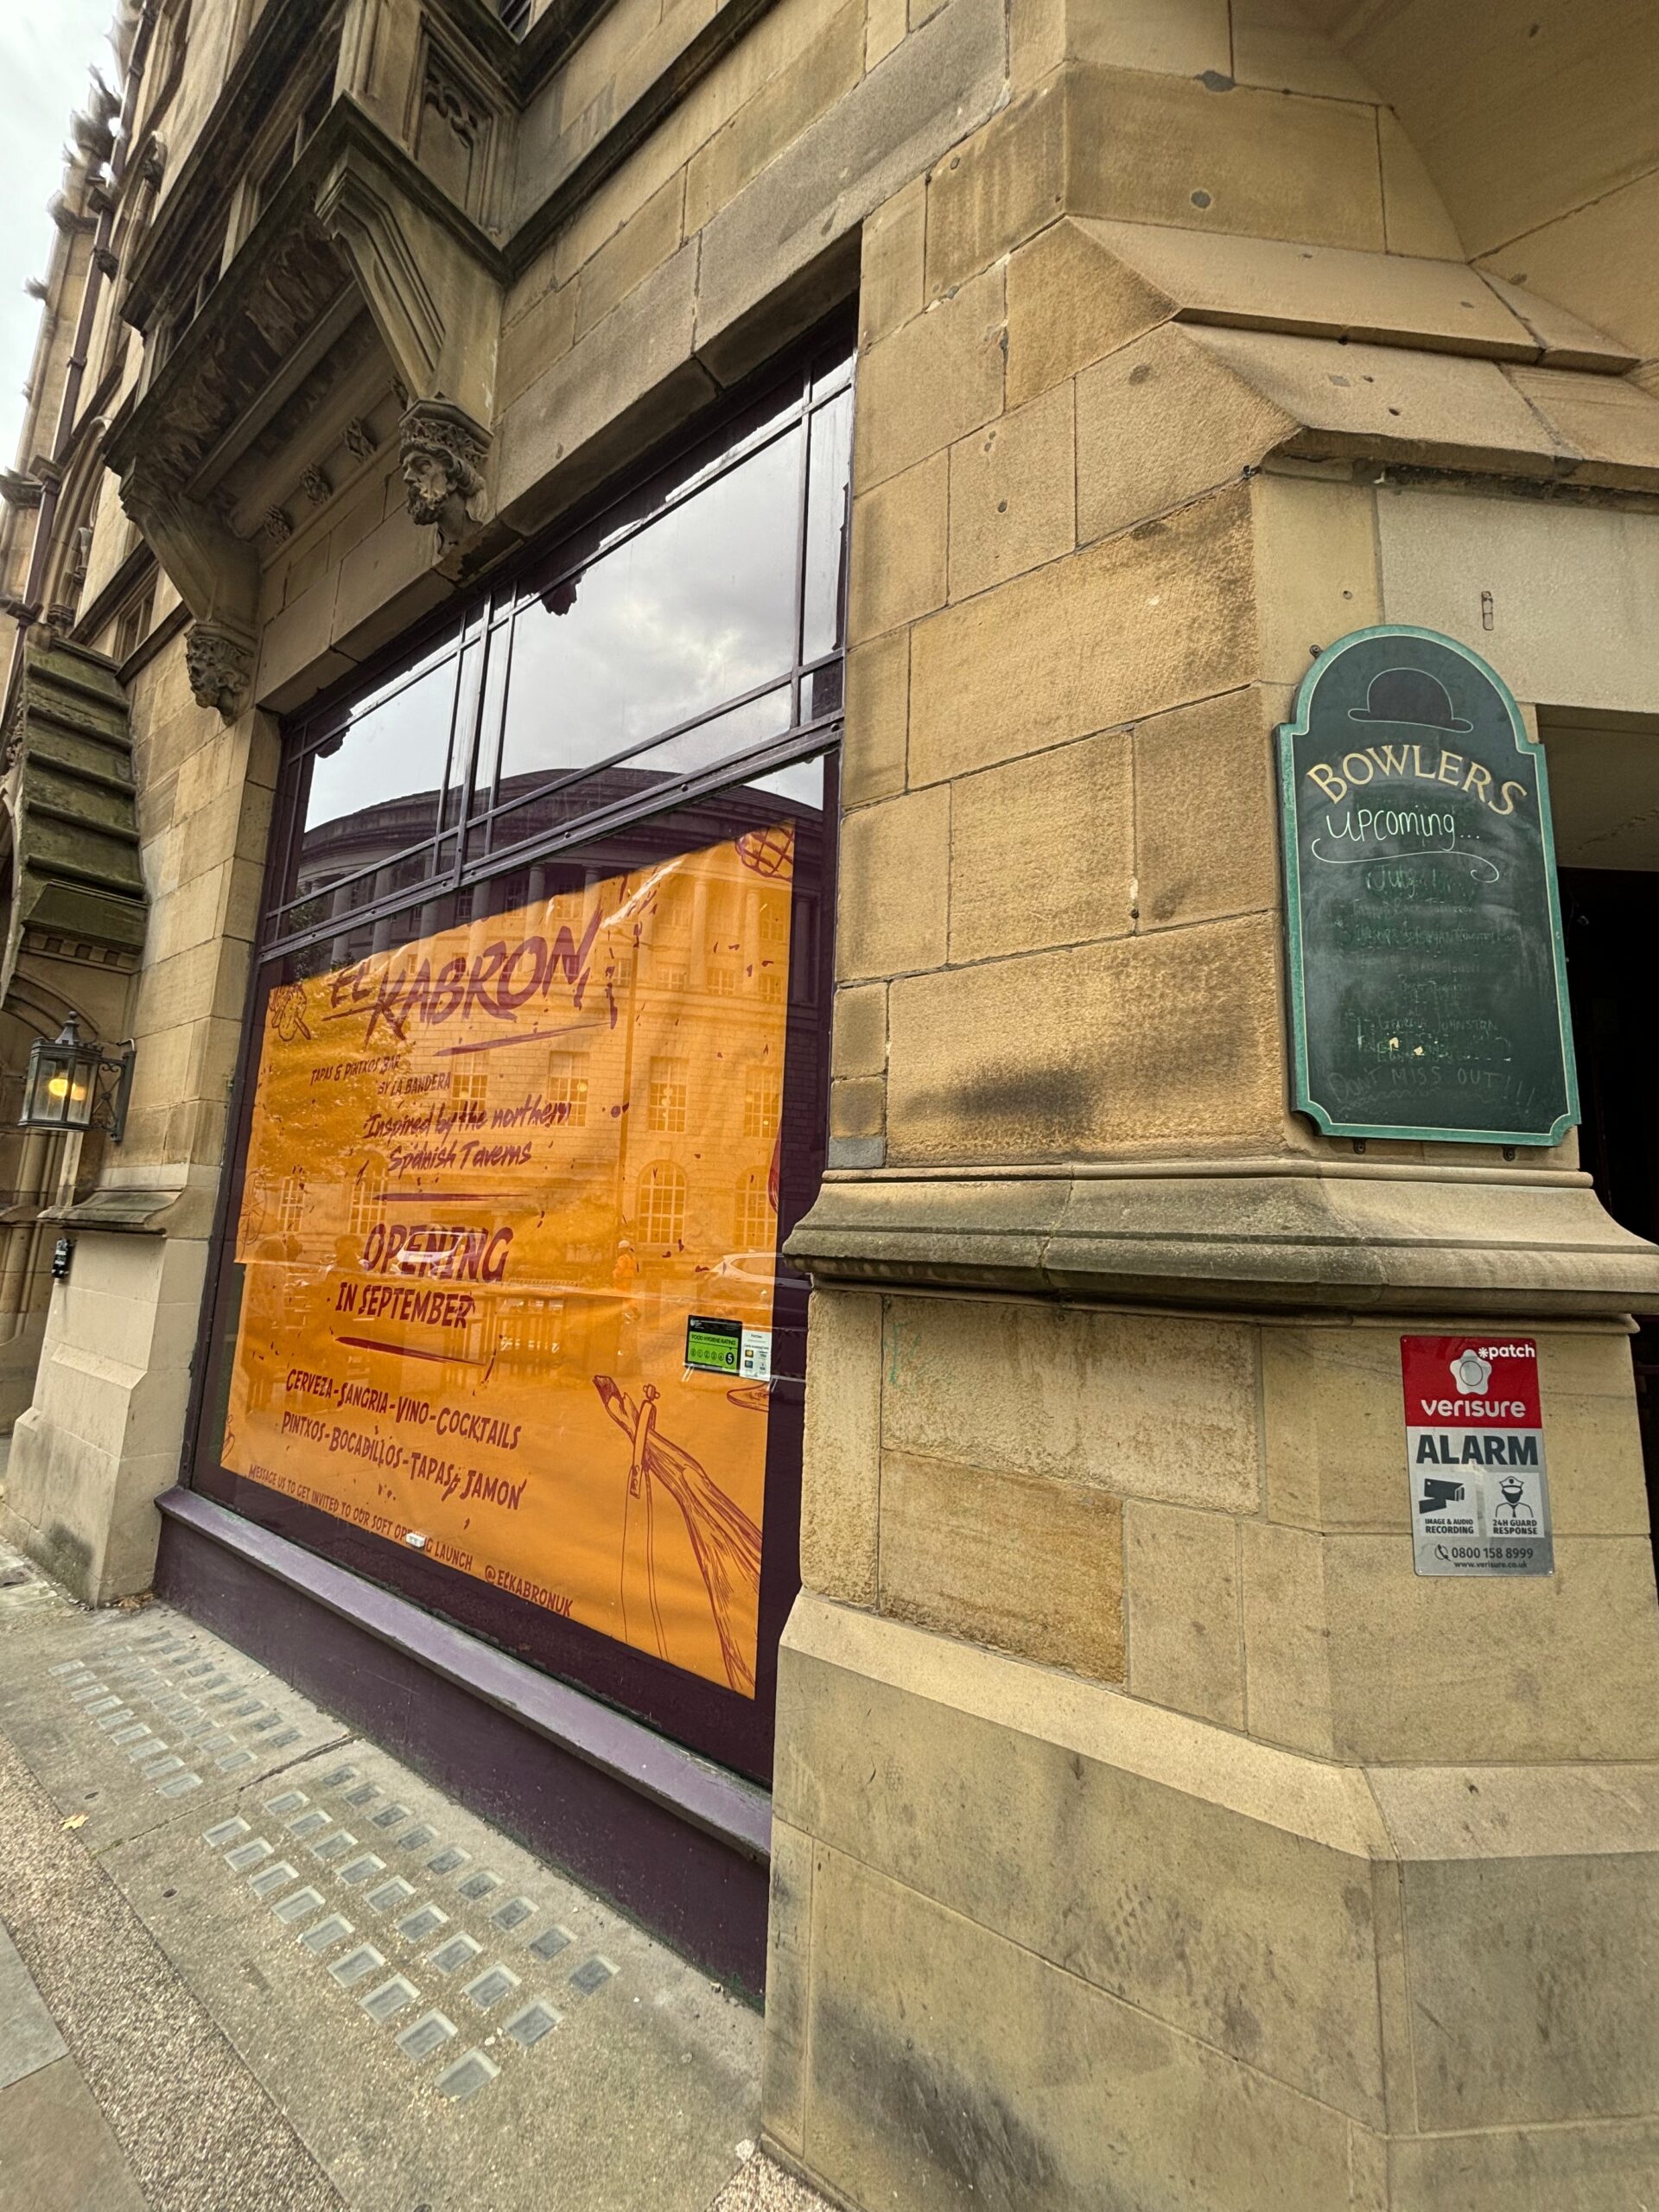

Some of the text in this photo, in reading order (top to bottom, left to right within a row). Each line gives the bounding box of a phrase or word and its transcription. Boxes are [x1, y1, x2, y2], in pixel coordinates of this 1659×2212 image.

[1306, 743, 1528, 816] BOWLERS
[328, 902, 603, 1048] EL KABRON
[310, 1066, 334, 1085] TAPAS
[391, 1079, 404, 1096] LA
[404, 1071, 452, 1095] BANDERA
[1391, 1065, 1441, 1086] MISS
[363, 1094, 573, 1143] Inspired by the northern
[388, 1141, 532, 1179] Spanish Taverns
[363, 1223, 514, 1283] OPENING
[334, 1282, 475, 1329] IN SEPTEMBER
[691, 1333, 703, 1342] FOOD
[703, 1336, 721, 1344] HYGIENE
[1489, 1344, 1535, 1359] patch
[1421, 1399, 1526, 1419] verisure
[1415, 1433, 1539, 1466] ALARM
[459, 1470, 524, 1510] JAMON
[248, 1463, 278, 1484] MESSAGE
[277, 1477, 287, 1490] US
[288, 1478, 296, 1495] TO
[296, 1485, 311, 1501] GET
[311, 1490, 340, 1512] INVITED
[341, 1502, 352, 1518] TO
[353, 1508, 371, 1526] OUR
[372, 1515, 394, 1535] SOFT
[434, 1541, 474, 1572] LAUNCH
[1425, 1526, 1474, 1535] RECORDING
[1492, 1527, 1538, 1535] RESPONSE
[1451, 1547, 1535, 1560] 0800 158 8999
[1453, 1560, 1528, 1569] www.verisure.co.uk
